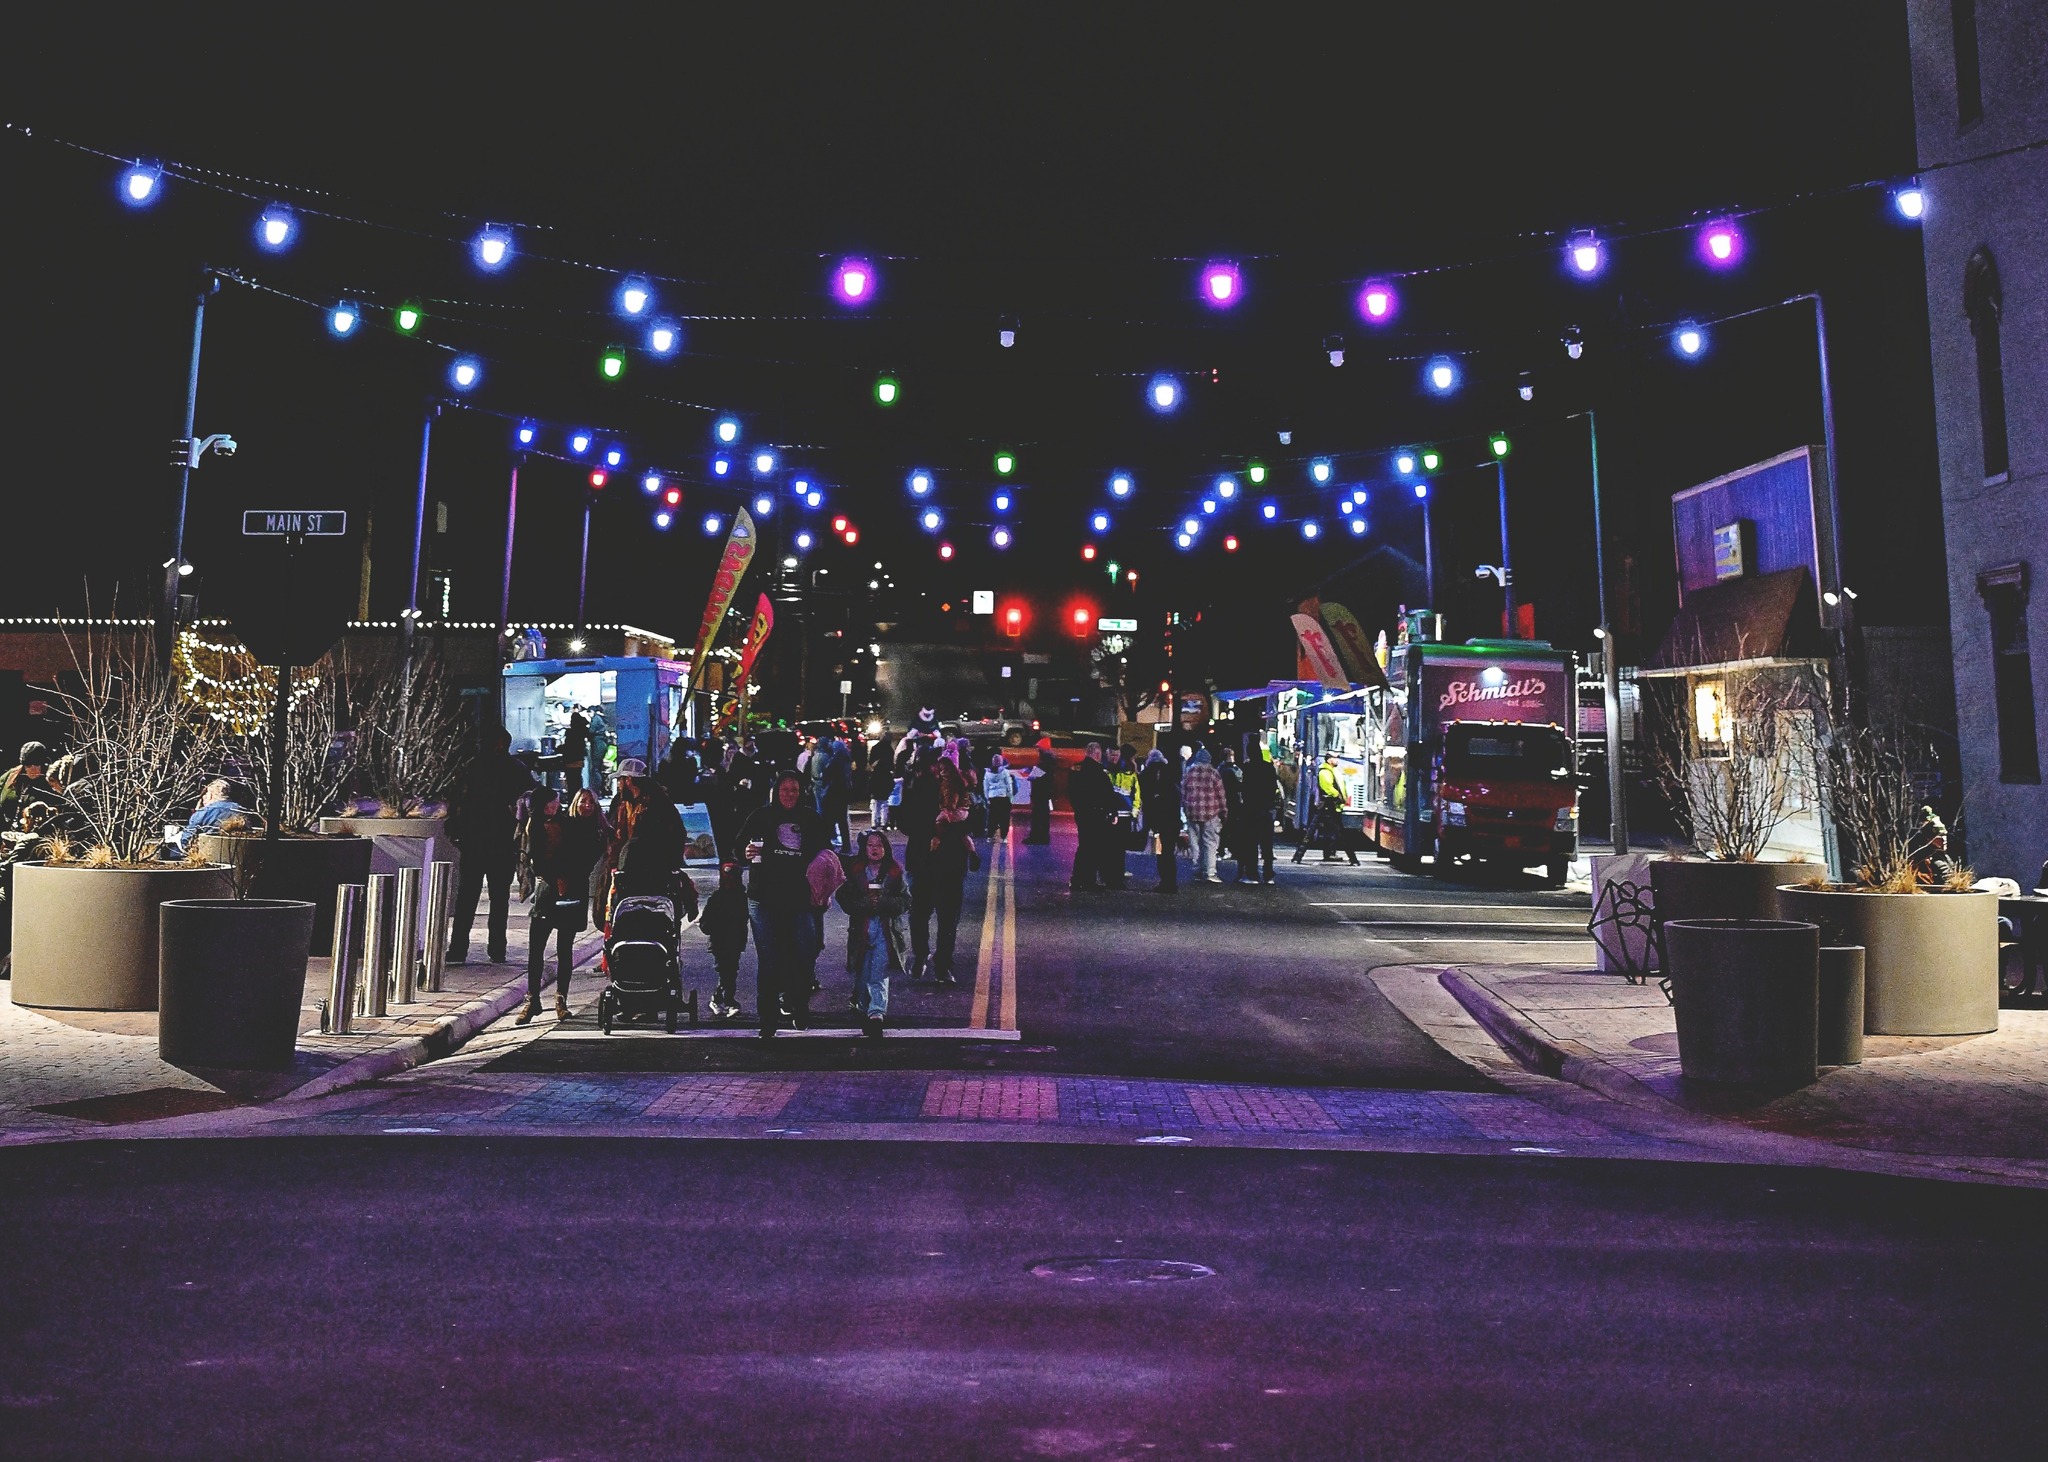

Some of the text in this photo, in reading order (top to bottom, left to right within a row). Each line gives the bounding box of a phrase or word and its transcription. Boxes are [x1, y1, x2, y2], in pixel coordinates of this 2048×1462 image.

[266, 514, 323, 531] MAIN ST
[1439, 678, 1546, 711] Schmidt's
